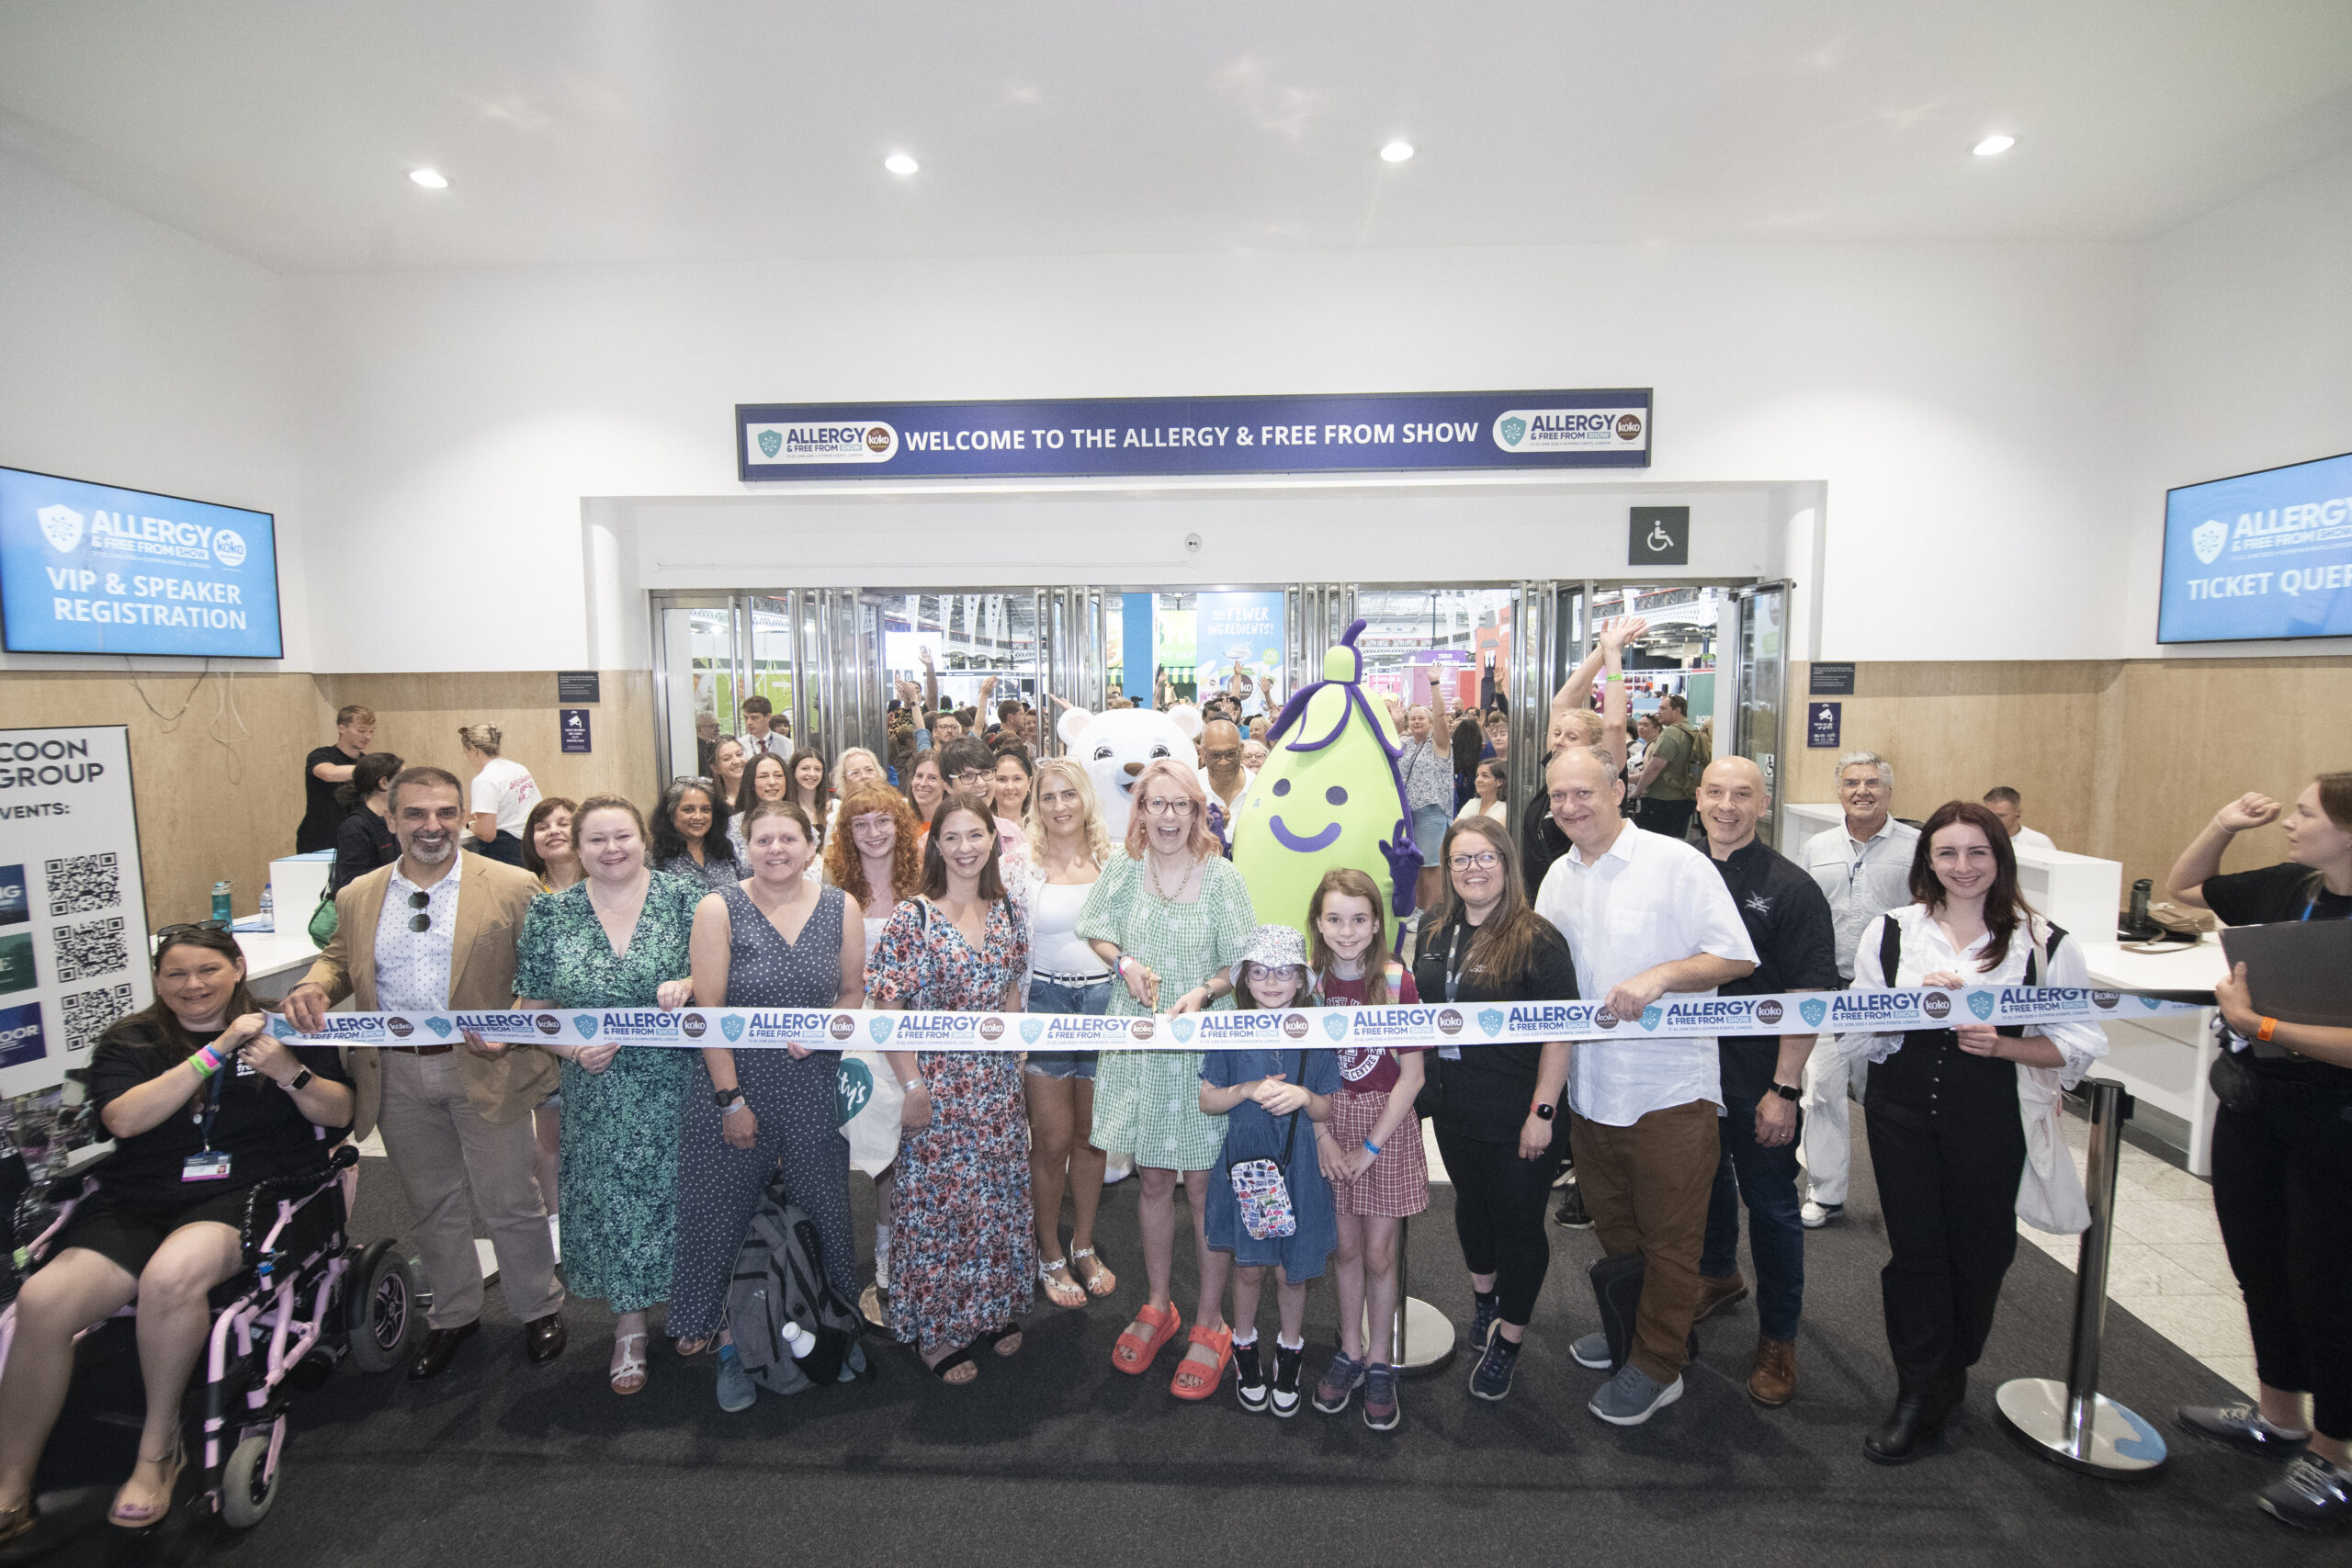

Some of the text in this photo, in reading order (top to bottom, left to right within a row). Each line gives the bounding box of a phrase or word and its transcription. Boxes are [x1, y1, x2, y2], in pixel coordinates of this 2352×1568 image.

[1531, 414, 1616, 432] ALLERGY
[1618, 422, 1640, 433] koko
[786, 427, 865, 444] ALLERGY
[868, 435, 889, 445] koko
[905, 423, 1479, 451] WELCOME TO THE ALLERGY & FREE FROM SHOW
[91, 510, 212, 548] ALLERGY
[91, 536, 102, 547] &
[104, 537, 136, 551] FREE
[138, 542, 175, 557] FROM
[217, 539, 244, 555] koko
[2232, 539, 2241, 552] &
[2244, 535, 2274, 551] FREE
[2275, 530, 2315, 547] FROM
[45, 566, 243, 604] VIP & SPEAKER
[2187, 571, 2275, 600] TICKET
[53, 597, 247, 630] REGISTRATION
[1227, 607, 1270, 621] FEWER
[1207, 623, 1274, 636] INGREDIENTS!
[0, 762, 104, 788] GROUP
[1832, 992, 1922, 1011] ALLERGY
[2000, 988, 2089, 1004] ALLERGY
[1668, 1000, 1757, 1017] ALLERGY
[1758, 1007, 1781, 1016] koko
[1926, 1000, 1949, 1010] koko
[2009, 1004, 2031, 1012] FREE
[2033, 1003, 2060, 1011] FROM
[456, 1014, 534, 1027] ALLERGY
[603, 1013, 682, 1028] ALLERGY
[750, 1013, 831, 1029] ALLERGY
[1201, 1014, 1283, 1030] ALLERGY
[1354, 1010, 1437, 1027] ALLERGY
[1440, 1017, 1462, 1027] koko
[1509, 1006, 1595, 1022] ALLERGY
[1864, 1011, 1891, 1020] FROM
[319, 1017, 385, 1032] LERGY
[537, 1020, 560, 1029] koko
[684, 1021, 706, 1030] koko
[832, 1022, 854, 1032] koko
[898, 1015, 981, 1031] ALLERGY
[981, 1023, 1003, 1032] koko
[1048, 1018, 1131, 1031] ALLERGY
[1285, 1021, 1307, 1031] koko
[1351, 1055, 1376, 1079] CENTRE
